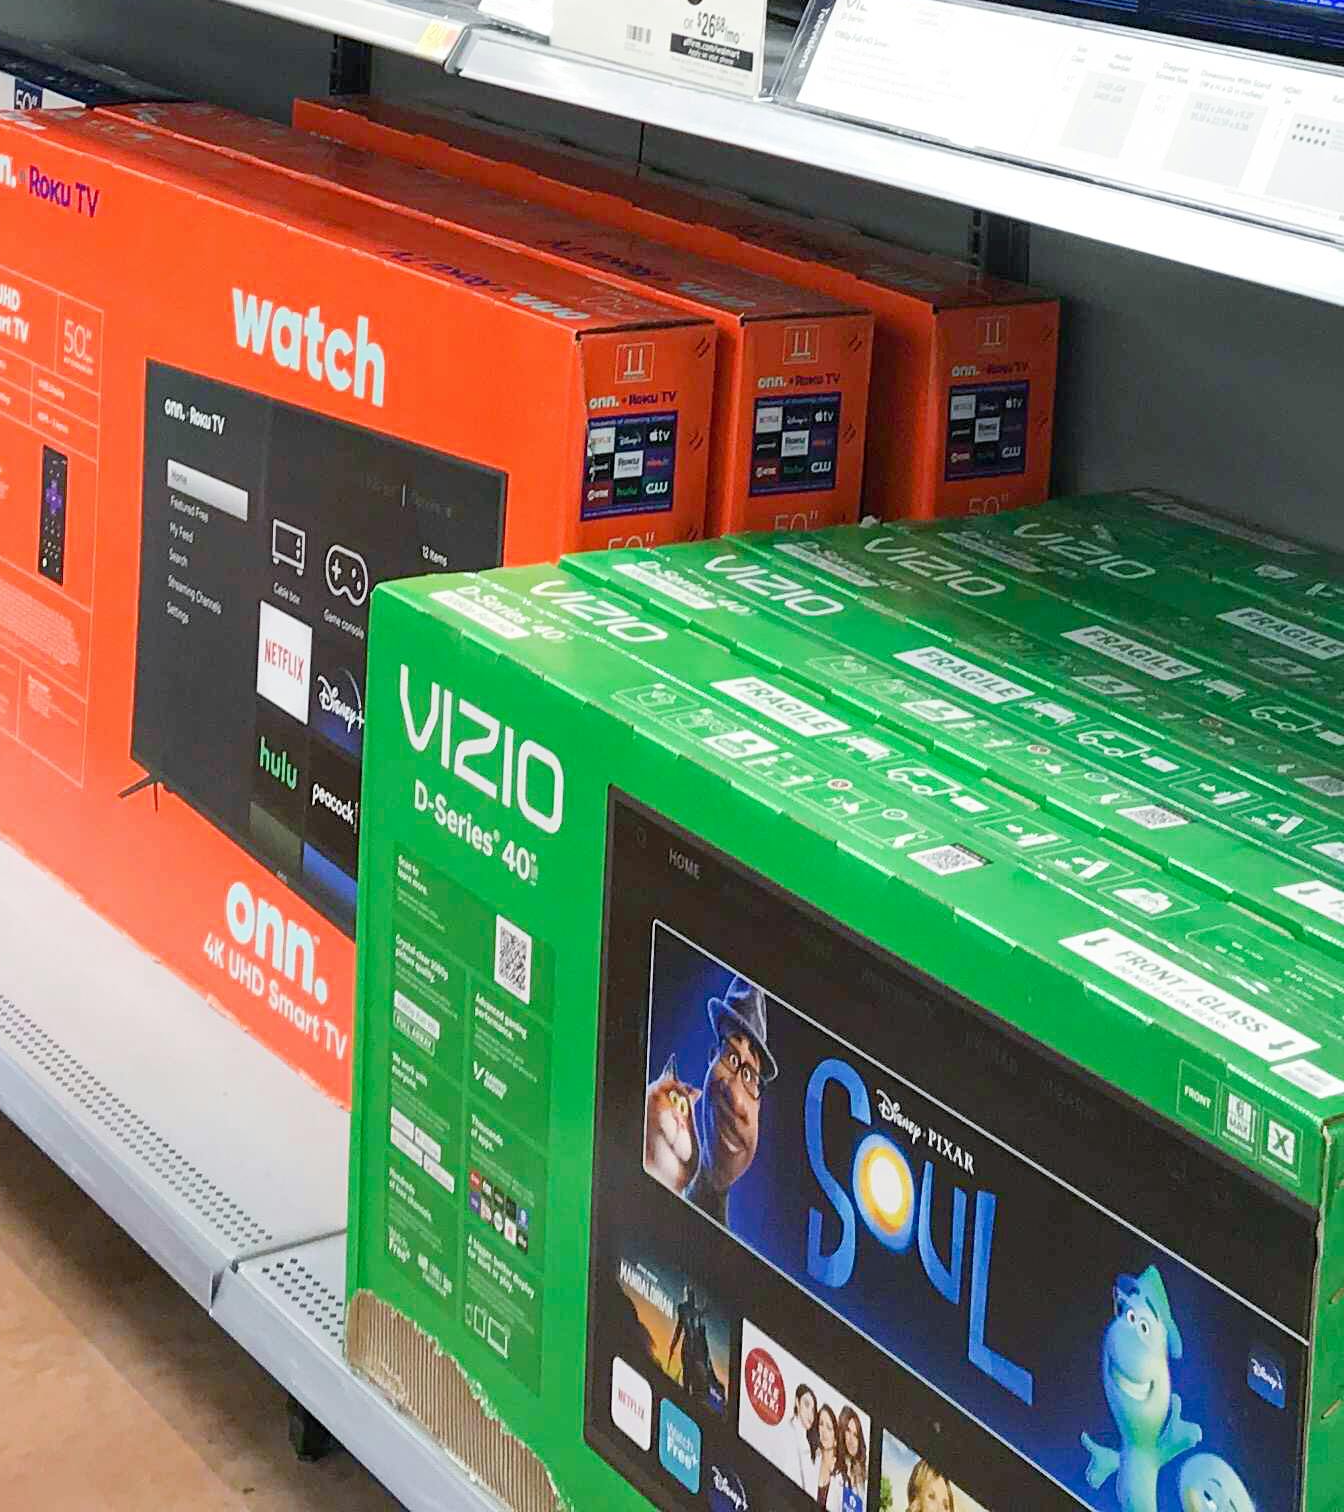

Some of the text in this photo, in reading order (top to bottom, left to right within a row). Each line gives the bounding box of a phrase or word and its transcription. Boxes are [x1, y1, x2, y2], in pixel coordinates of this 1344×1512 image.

[75, 183, 100, 218] TV
[13, 317, 29, 344] TV
[231, 287, 386, 409] watch
[168, 549, 188, 569] Search
[864, 536, 1006, 596] VIZIO
[1013, 523, 1154, 580] VIZIO
[530, 580, 667, 643] VIZIO
[704, 555, 844, 616] VIZIO
[1086, 629, 1188, 677] FRAGILE
[1241, 609, 1342, 655] FRAGILE
[264, 639, 305, 684] NETFLIX
[919, 650, 1022, 701] FRAGILE
[317, 672, 366, 733] Disney+
[734, 680, 836, 733] FRAGILE
[259, 736, 298, 790] hulu
[400, 663, 564, 834] VIZIO
[312, 782, 355, 826] peacock
[669, 848, 701, 880] HOME
[226, 882, 328, 1005] onn.
[203, 932, 347, 1061] 4K UHD Smart TV
[1115, 949, 1188, 987] FRONT
[1197, 993, 1269, 1034] GLASS
[1184, 1085, 1212, 1109] FRONT
[876, 1089, 976, 1176] Disney PIXAR
[803, 1057, 1034, 1407] SOUL
[620, 1258, 674, 1319] MANDALORIAN
[618, 1388, 645, 1421] NETFLIX
